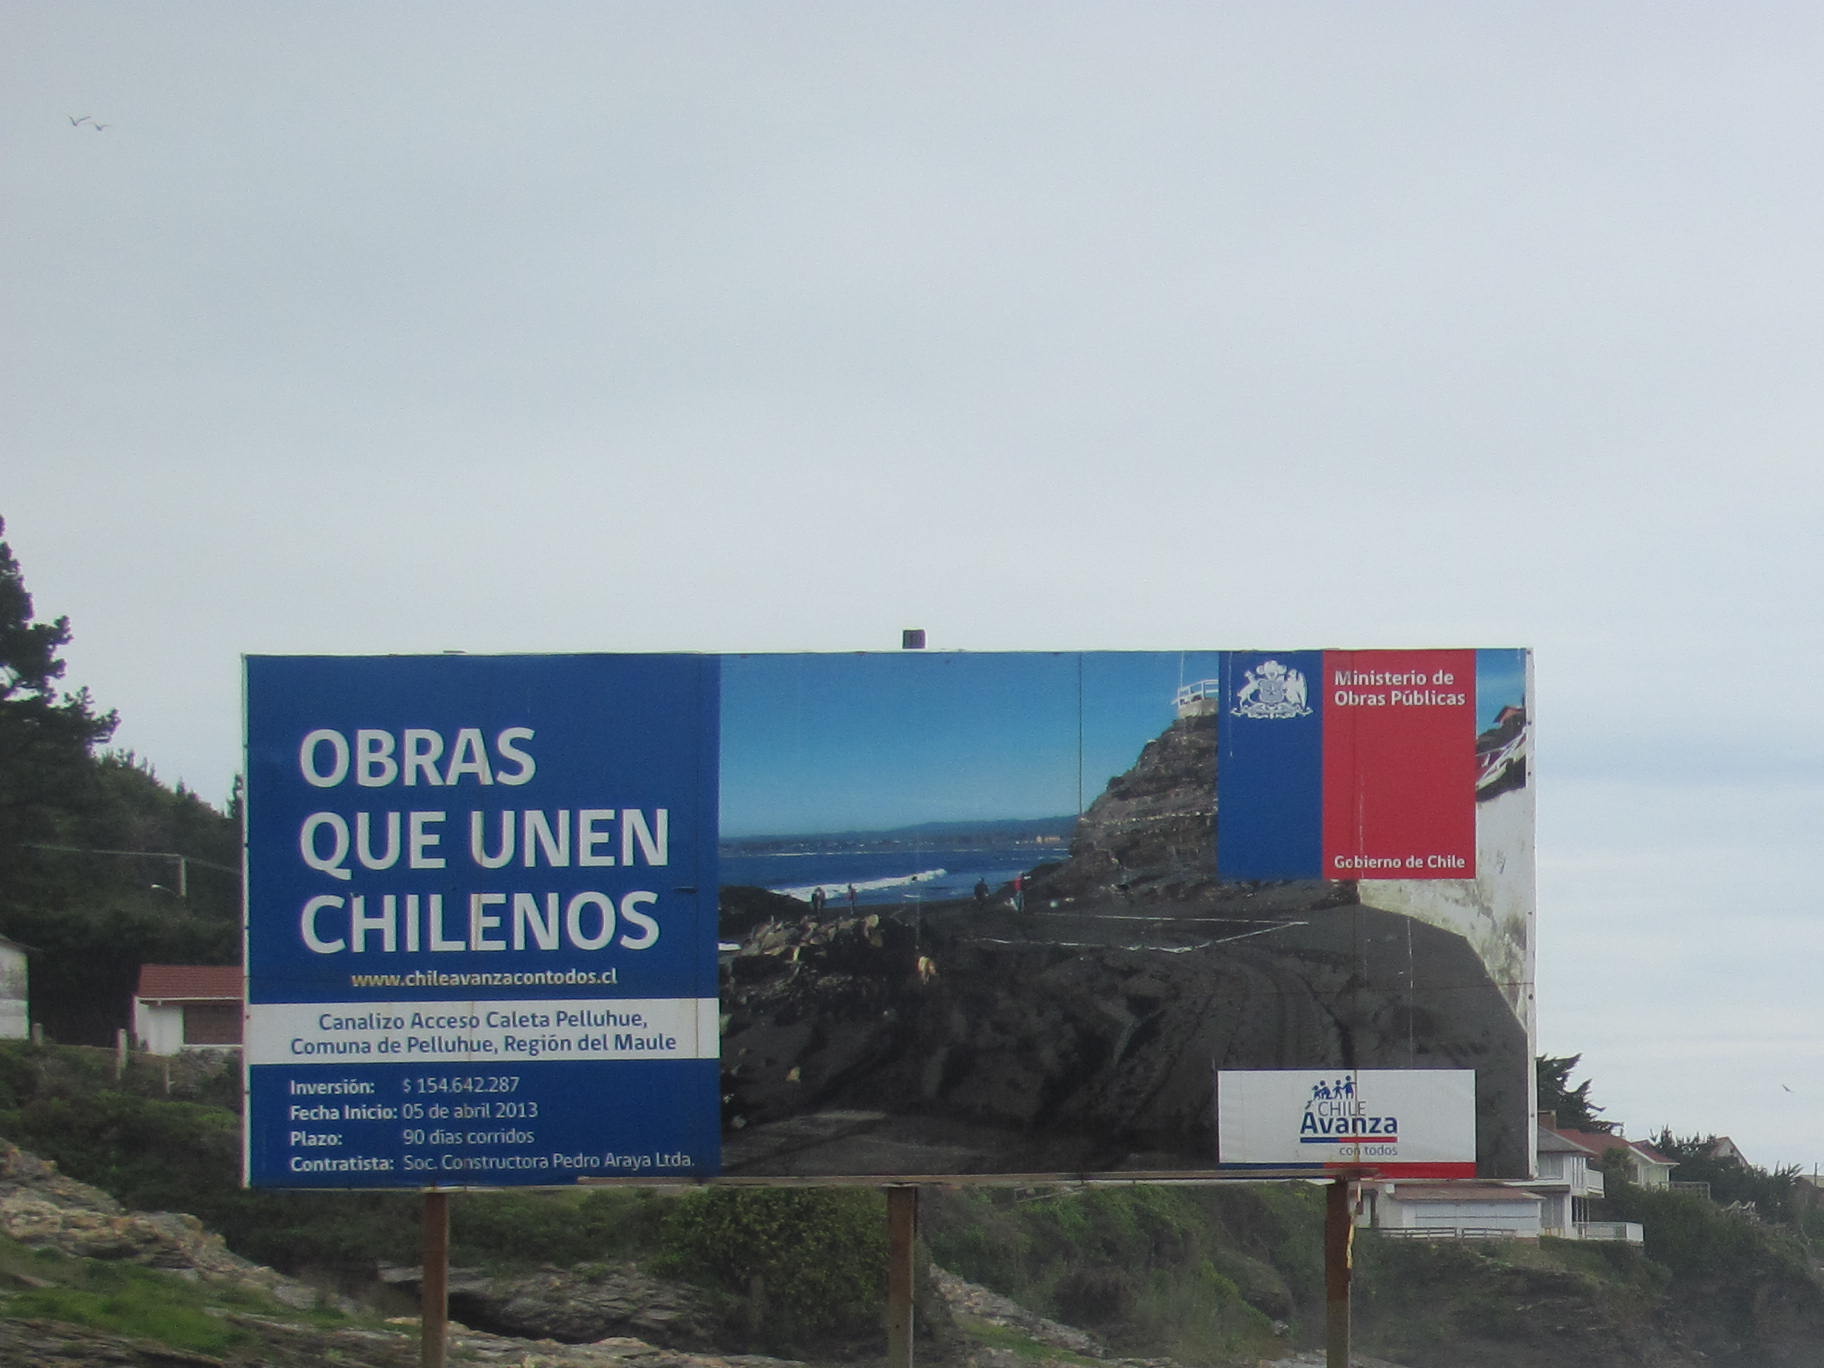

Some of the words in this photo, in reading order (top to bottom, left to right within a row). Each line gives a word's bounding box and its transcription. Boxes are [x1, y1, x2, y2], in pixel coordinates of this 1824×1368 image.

[1334, 670, 1428, 686] Ministerio
[1432, 669, 1454, 685] de
[1334, 690, 1386, 706] Obras
[1390, 690, 1466, 706] Públicas
[300, 727, 537, 788] OBRAS
[301, 811, 447, 880] QUE
[470, 808, 669, 868] UNEN
[1334, 855, 1402, 869] Gobierno
[1405, 855, 1424, 869] de
[1427, 854, 1466, 869] Chile
[301, 891, 661, 954] CHILENOS
[351, 968, 618, 987] www.chileavanzacontodos.cl
[319, 1013, 405, 1031] Canalizo
[410, 1012, 480, 1030] Acceso
[486, 1011, 550, 1029] Caleta
[556, 1009, 648, 1030] Pelluhue,
[290, 1037, 371, 1055] Comuna
[377, 1036, 402, 1054] de
[407, 1035, 499, 1055] Pelluhue,
[504, 1034, 573, 1056] Región
[577, 1033, 608, 1052] del
[614, 1032, 677, 1051] Maule
[289, 1079, 375, 1095] Inversión:
[402, 1079, 412, 1094] $
[416, 1076, 520, 1094] 154.642.287
[289, 1105, 340, 1120] Fecha
[344, 1104, 398, 1120] Inicio:
[402, 1104, 424, 1119] 05
[428, 1103, 450, 1119] de
[453, 1103, 491, 1118] abril
[495, 1102, 539, 1119] 2013
[1317, 1101, 1367, 1117] CHILE
[1300, 1111, 1398, 1134] Avanza
[289, 1131, 343, 1147] Plazo:
[402, 1129, 425, 1145] 90
[466, 1127, 536, 1144] corridos
[1339, 1146, 1361, 1156] con
[1364, 1144, 1398, 1156] todos
[290, 1156, 395, 1172] Contratista:
[403, 1154, 438, 1171] Soc.
[441, 1154, 549, 1170] Constructora
[552, 1152, 601, 1169] Pedro
[604, 1152, 652, 1171] Araya
[656, 1152, 696, 1168] Ltda.
